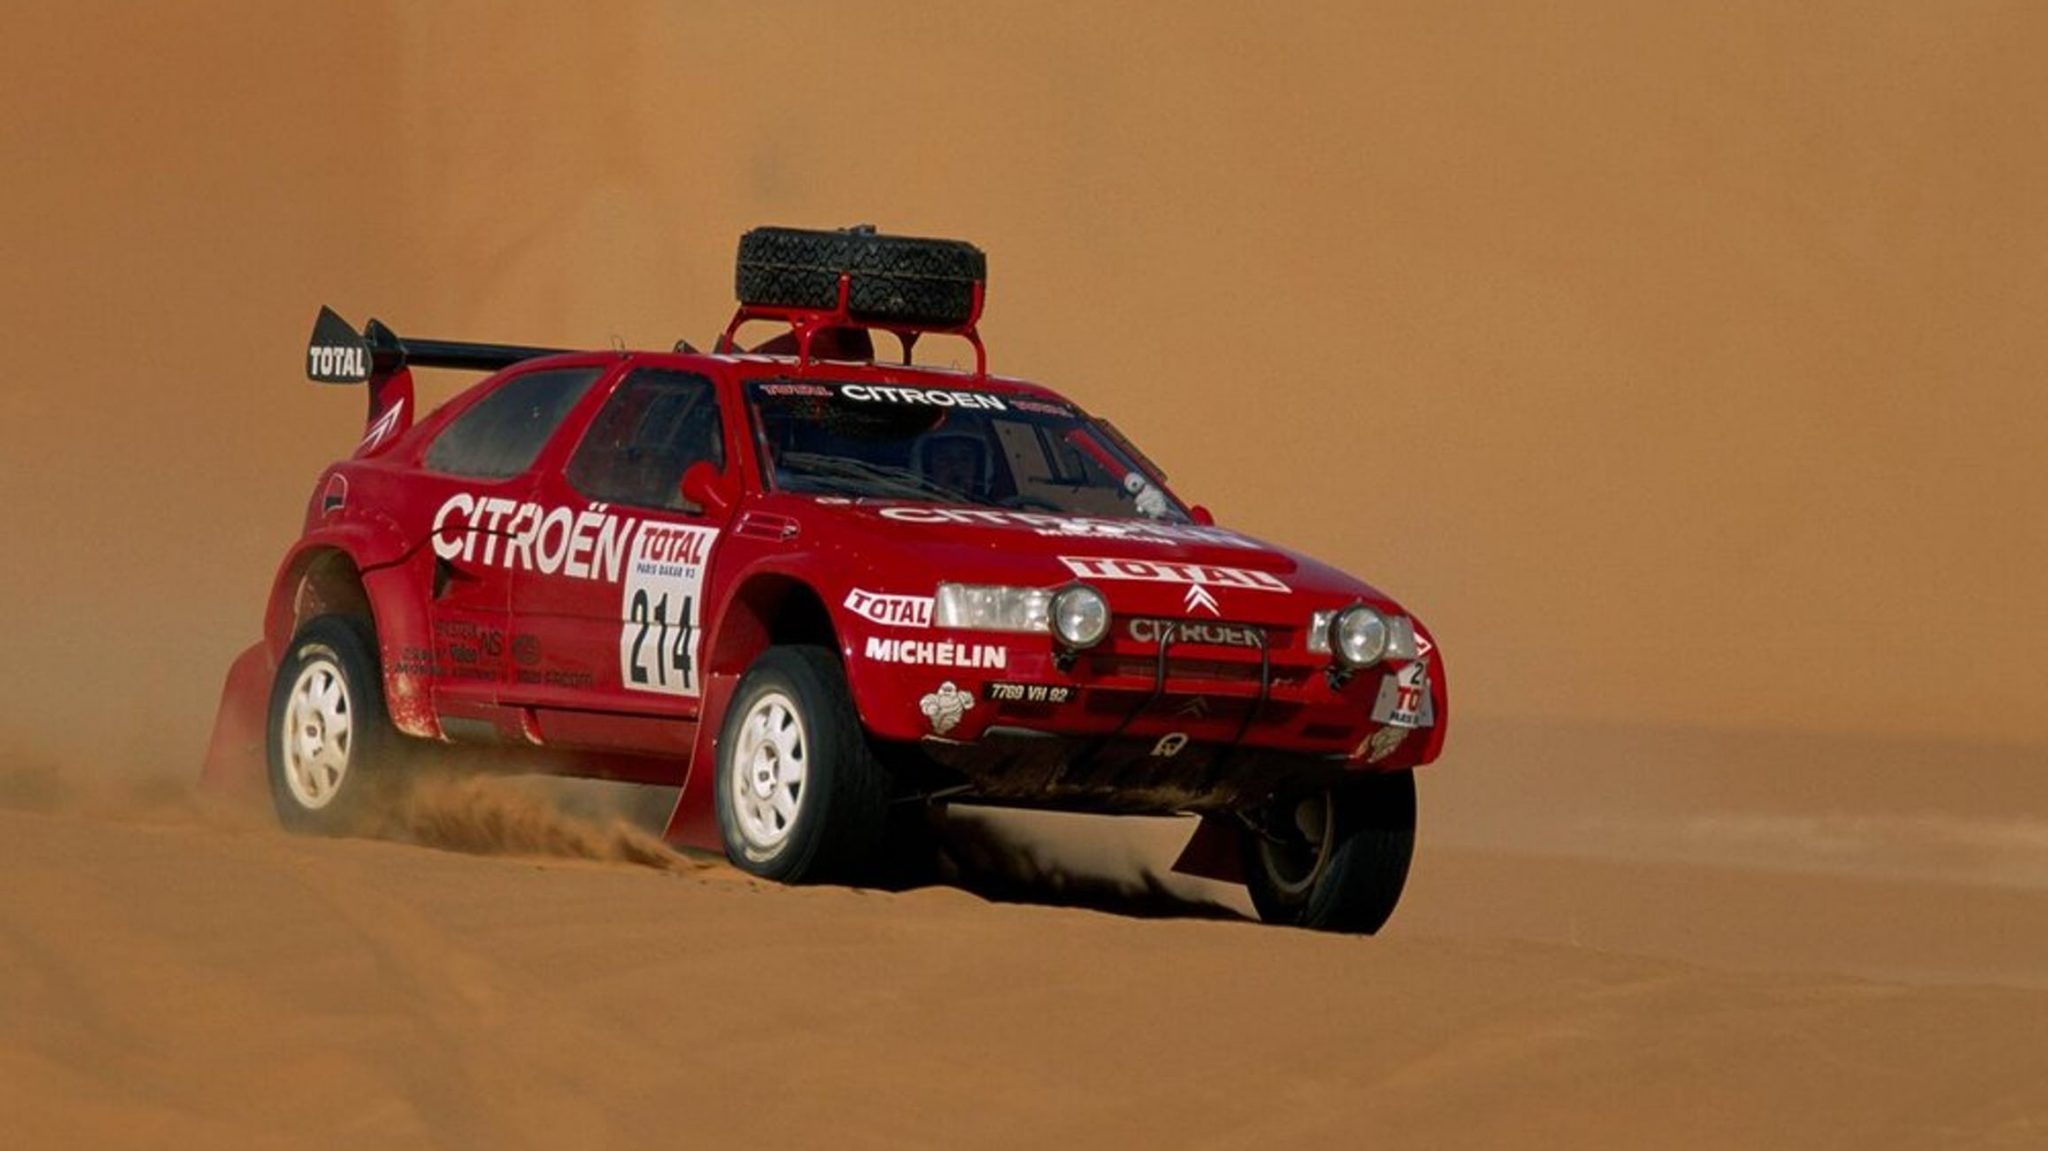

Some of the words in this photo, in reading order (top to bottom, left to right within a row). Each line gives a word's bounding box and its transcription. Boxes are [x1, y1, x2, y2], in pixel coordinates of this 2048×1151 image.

[310, 346, 365, 376] TOTAL
[431, 493, 635, 583] CITROËN
[640, 527, 706, 565] TOTAL
[1064, 558, 1286, 590] TOTAL
[852, 591, 927, 623] TOTAL
[630, 589, 692, 688] 214
[865, 636, 1007, 669] MICHELIN
[1028, 685, 1047, 701] VH
